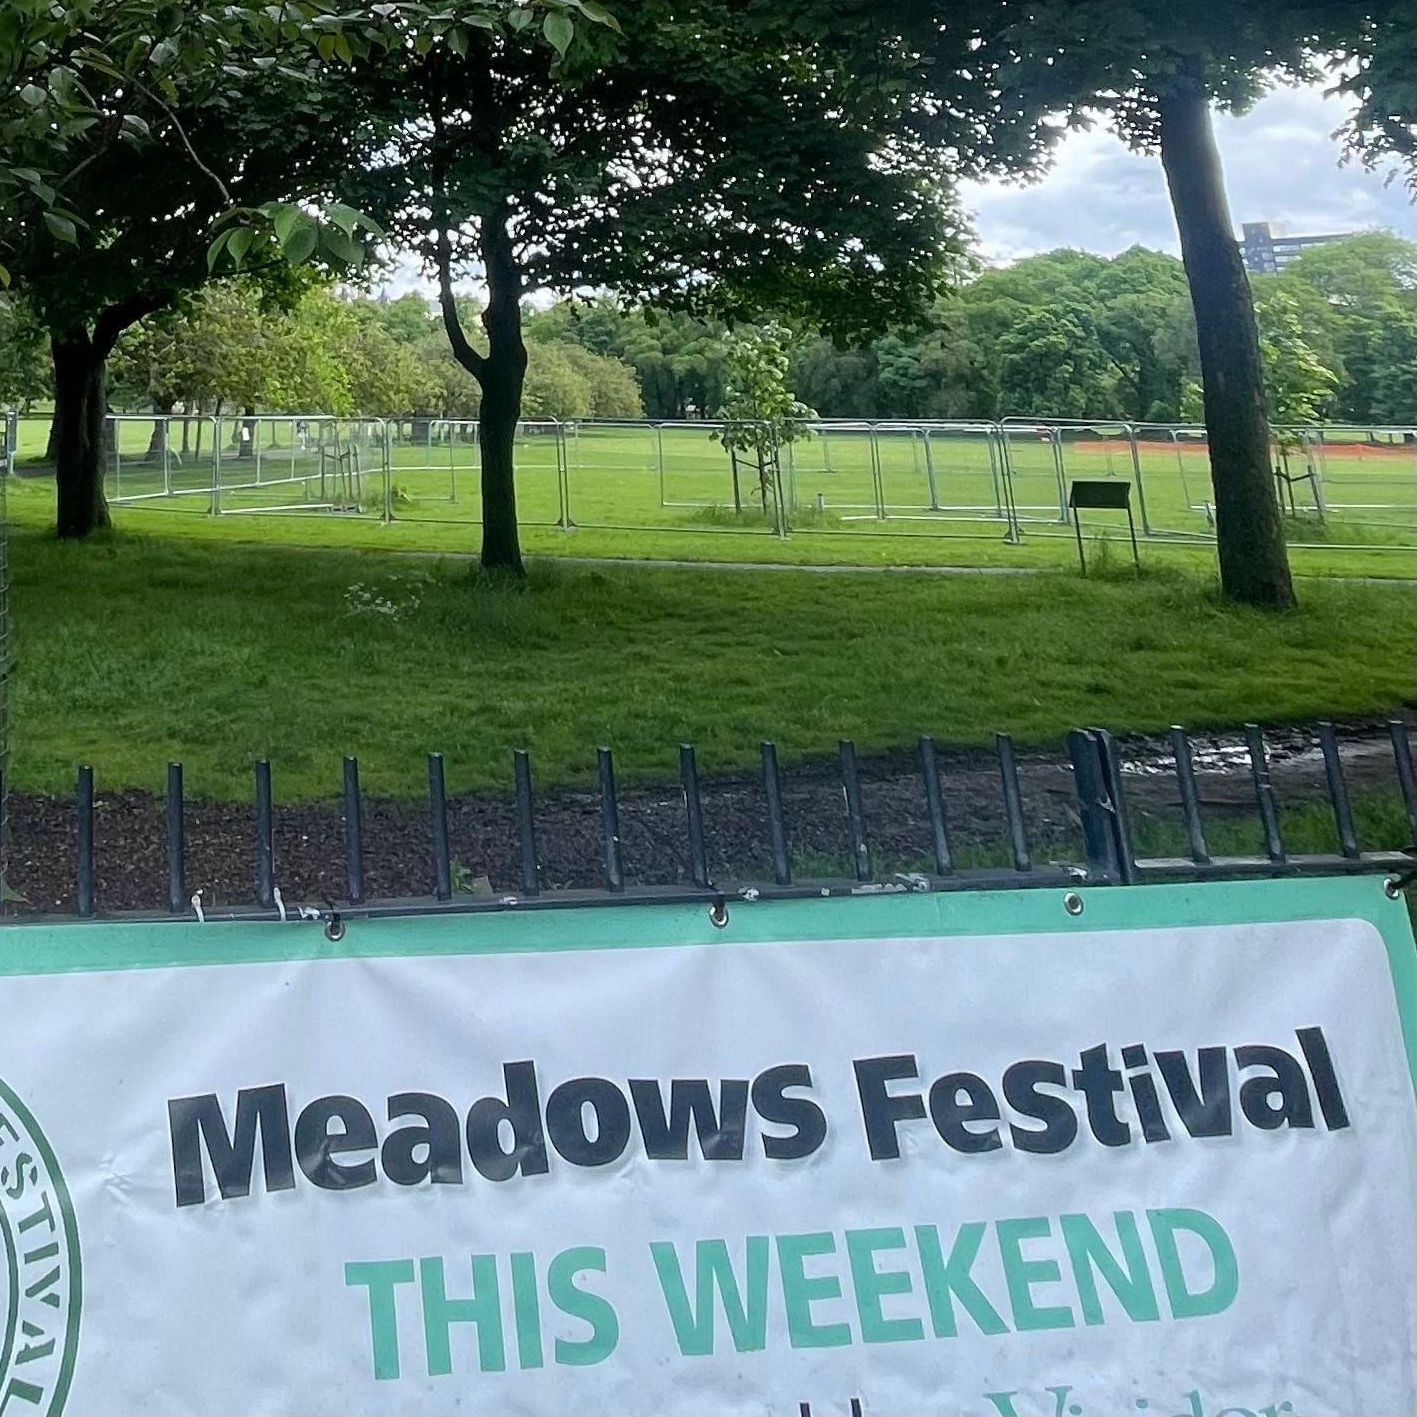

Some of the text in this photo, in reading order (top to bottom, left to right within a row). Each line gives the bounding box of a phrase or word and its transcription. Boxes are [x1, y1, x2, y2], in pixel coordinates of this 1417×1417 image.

[167, 1025, 1350, 1208] Meadows Festival
[344, 1208, 1240, 1381] THIS WEEKEND
